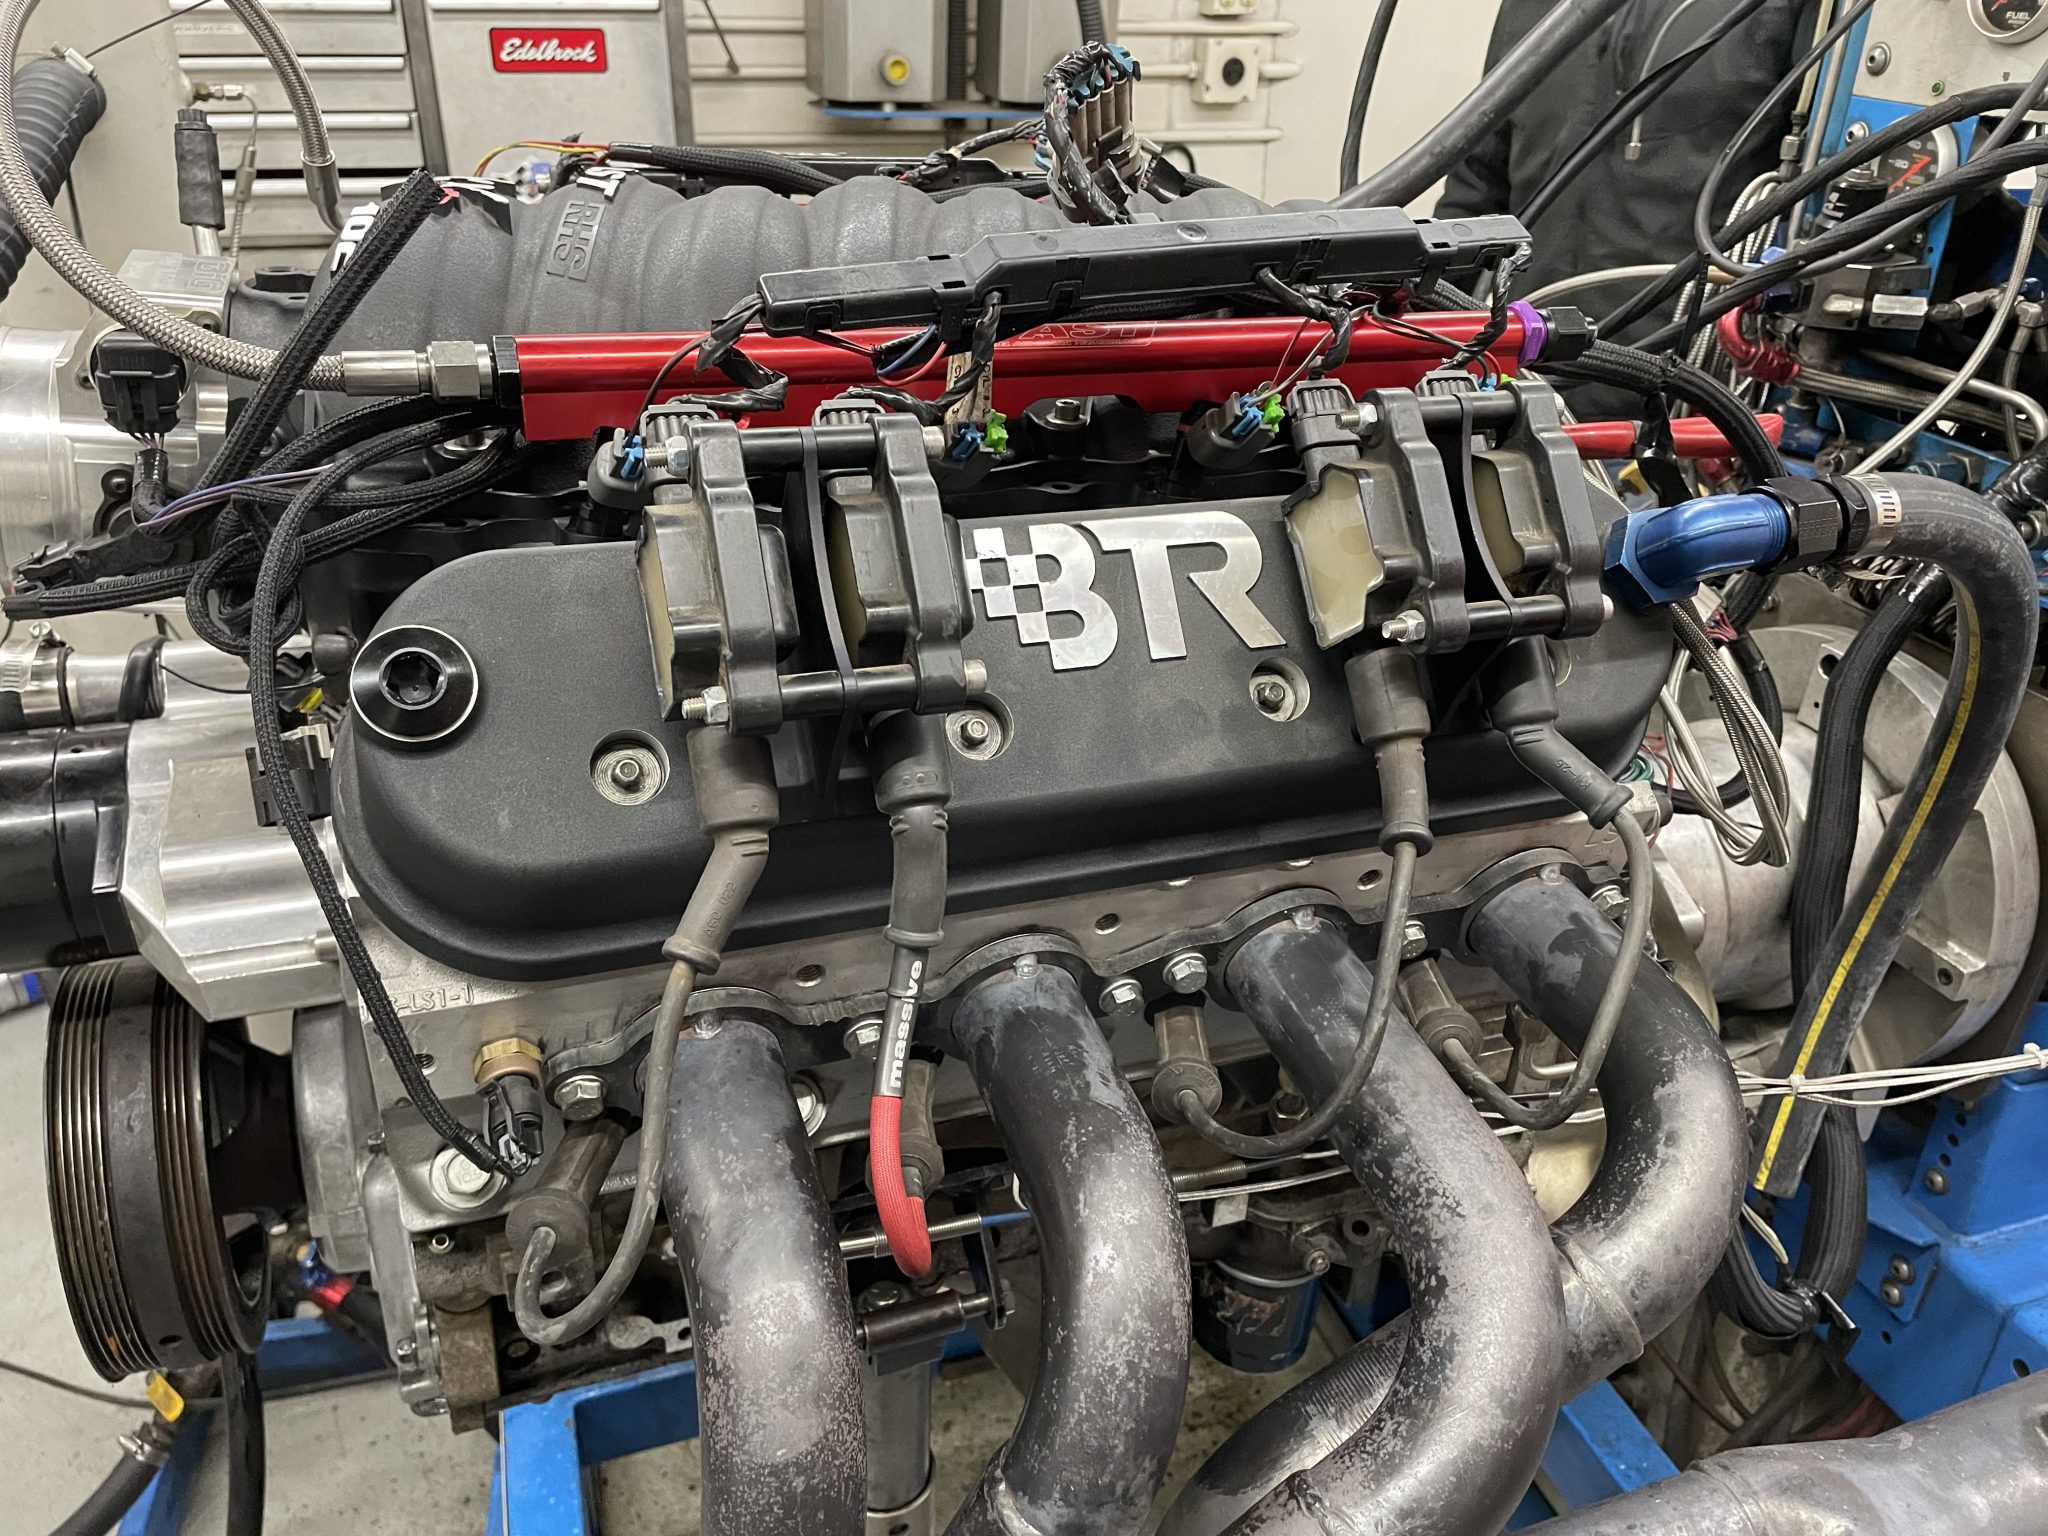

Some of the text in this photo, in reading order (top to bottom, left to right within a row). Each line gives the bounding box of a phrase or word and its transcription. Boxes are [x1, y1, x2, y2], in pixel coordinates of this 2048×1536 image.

[2005, 11, 2031, 20] FUEL
[500, 37, 598, 62] Edelbrock
[1019, 323, 1150, 340] AST
[965, 510, 1287, 670] BTR
[889, 960, 923, 1088] massive
